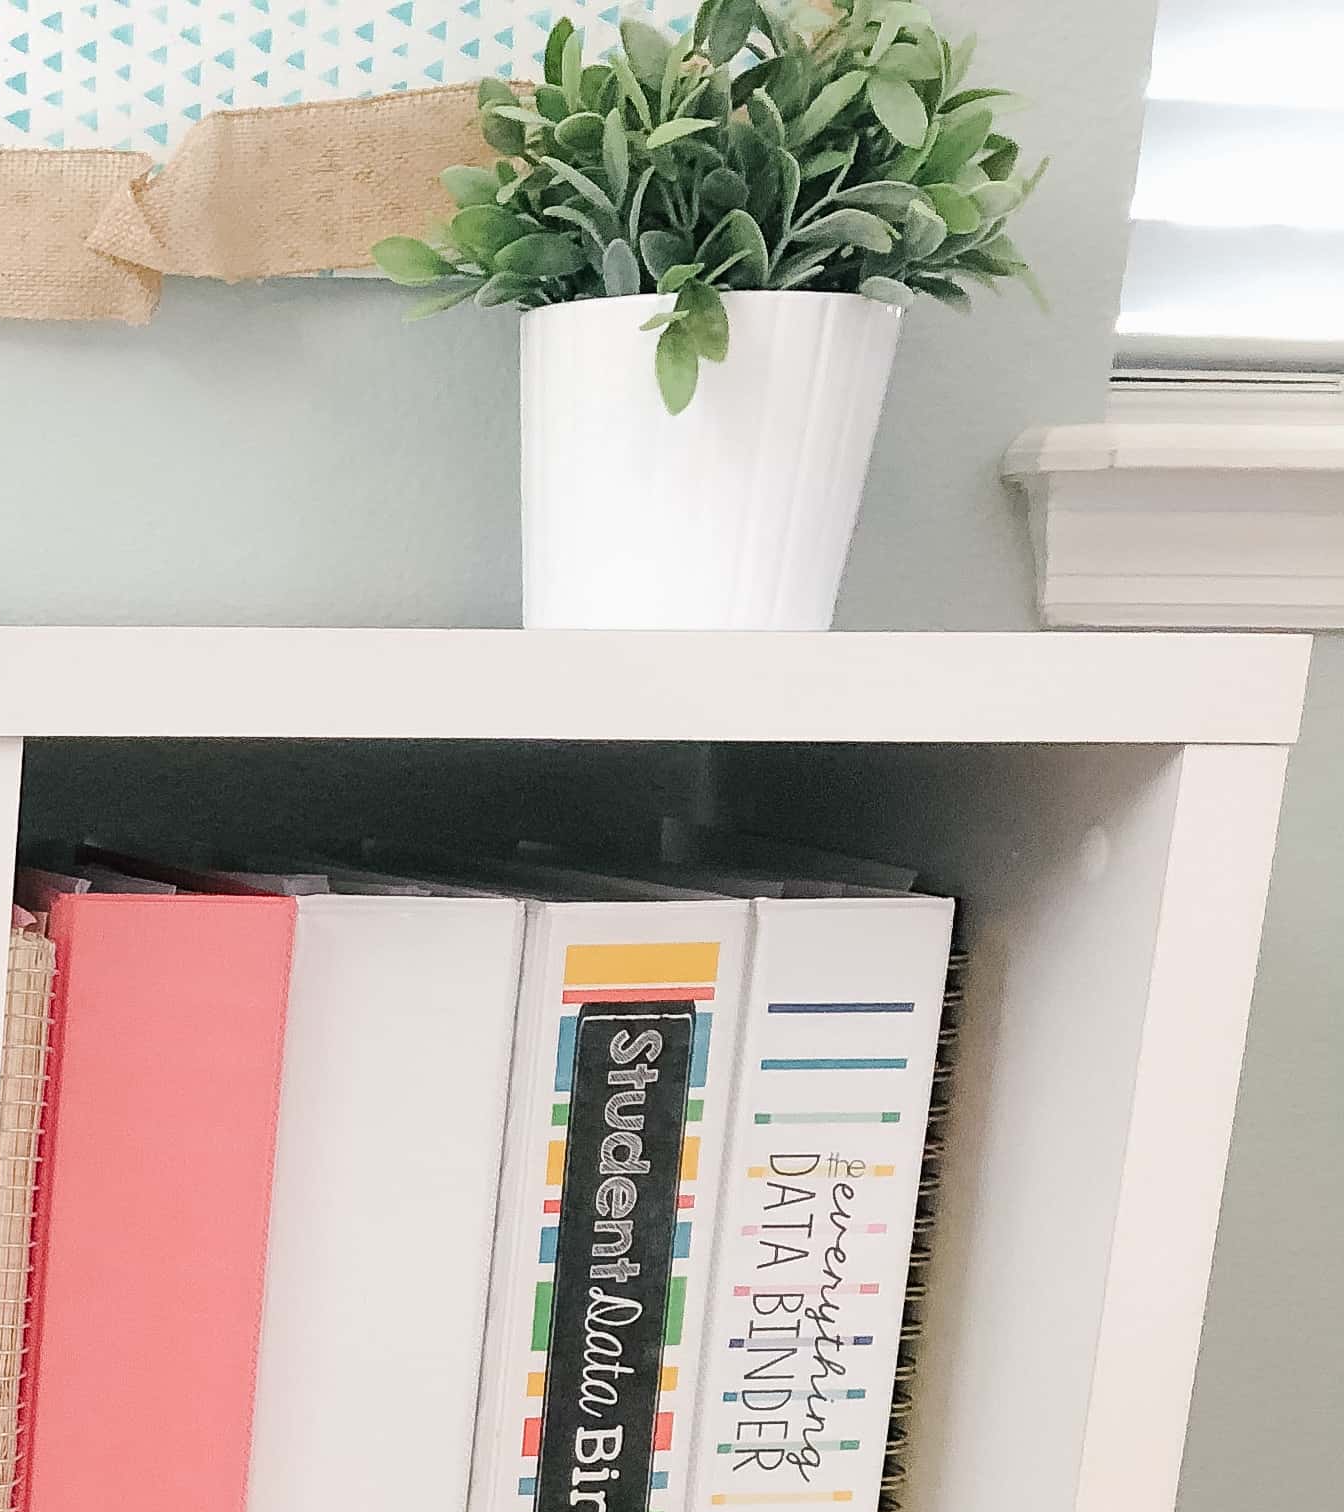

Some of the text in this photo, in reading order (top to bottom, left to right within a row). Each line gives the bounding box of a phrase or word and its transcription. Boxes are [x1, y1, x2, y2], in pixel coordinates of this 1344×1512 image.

[589, 1029, 663, 1282] Student
[828, 1152, 865, 1179] the
[578, 1287, 643, 1416] Data
[733, 1153, 820, 1471] DATA BINDER
[787, 1183, 858, 1482] everything
